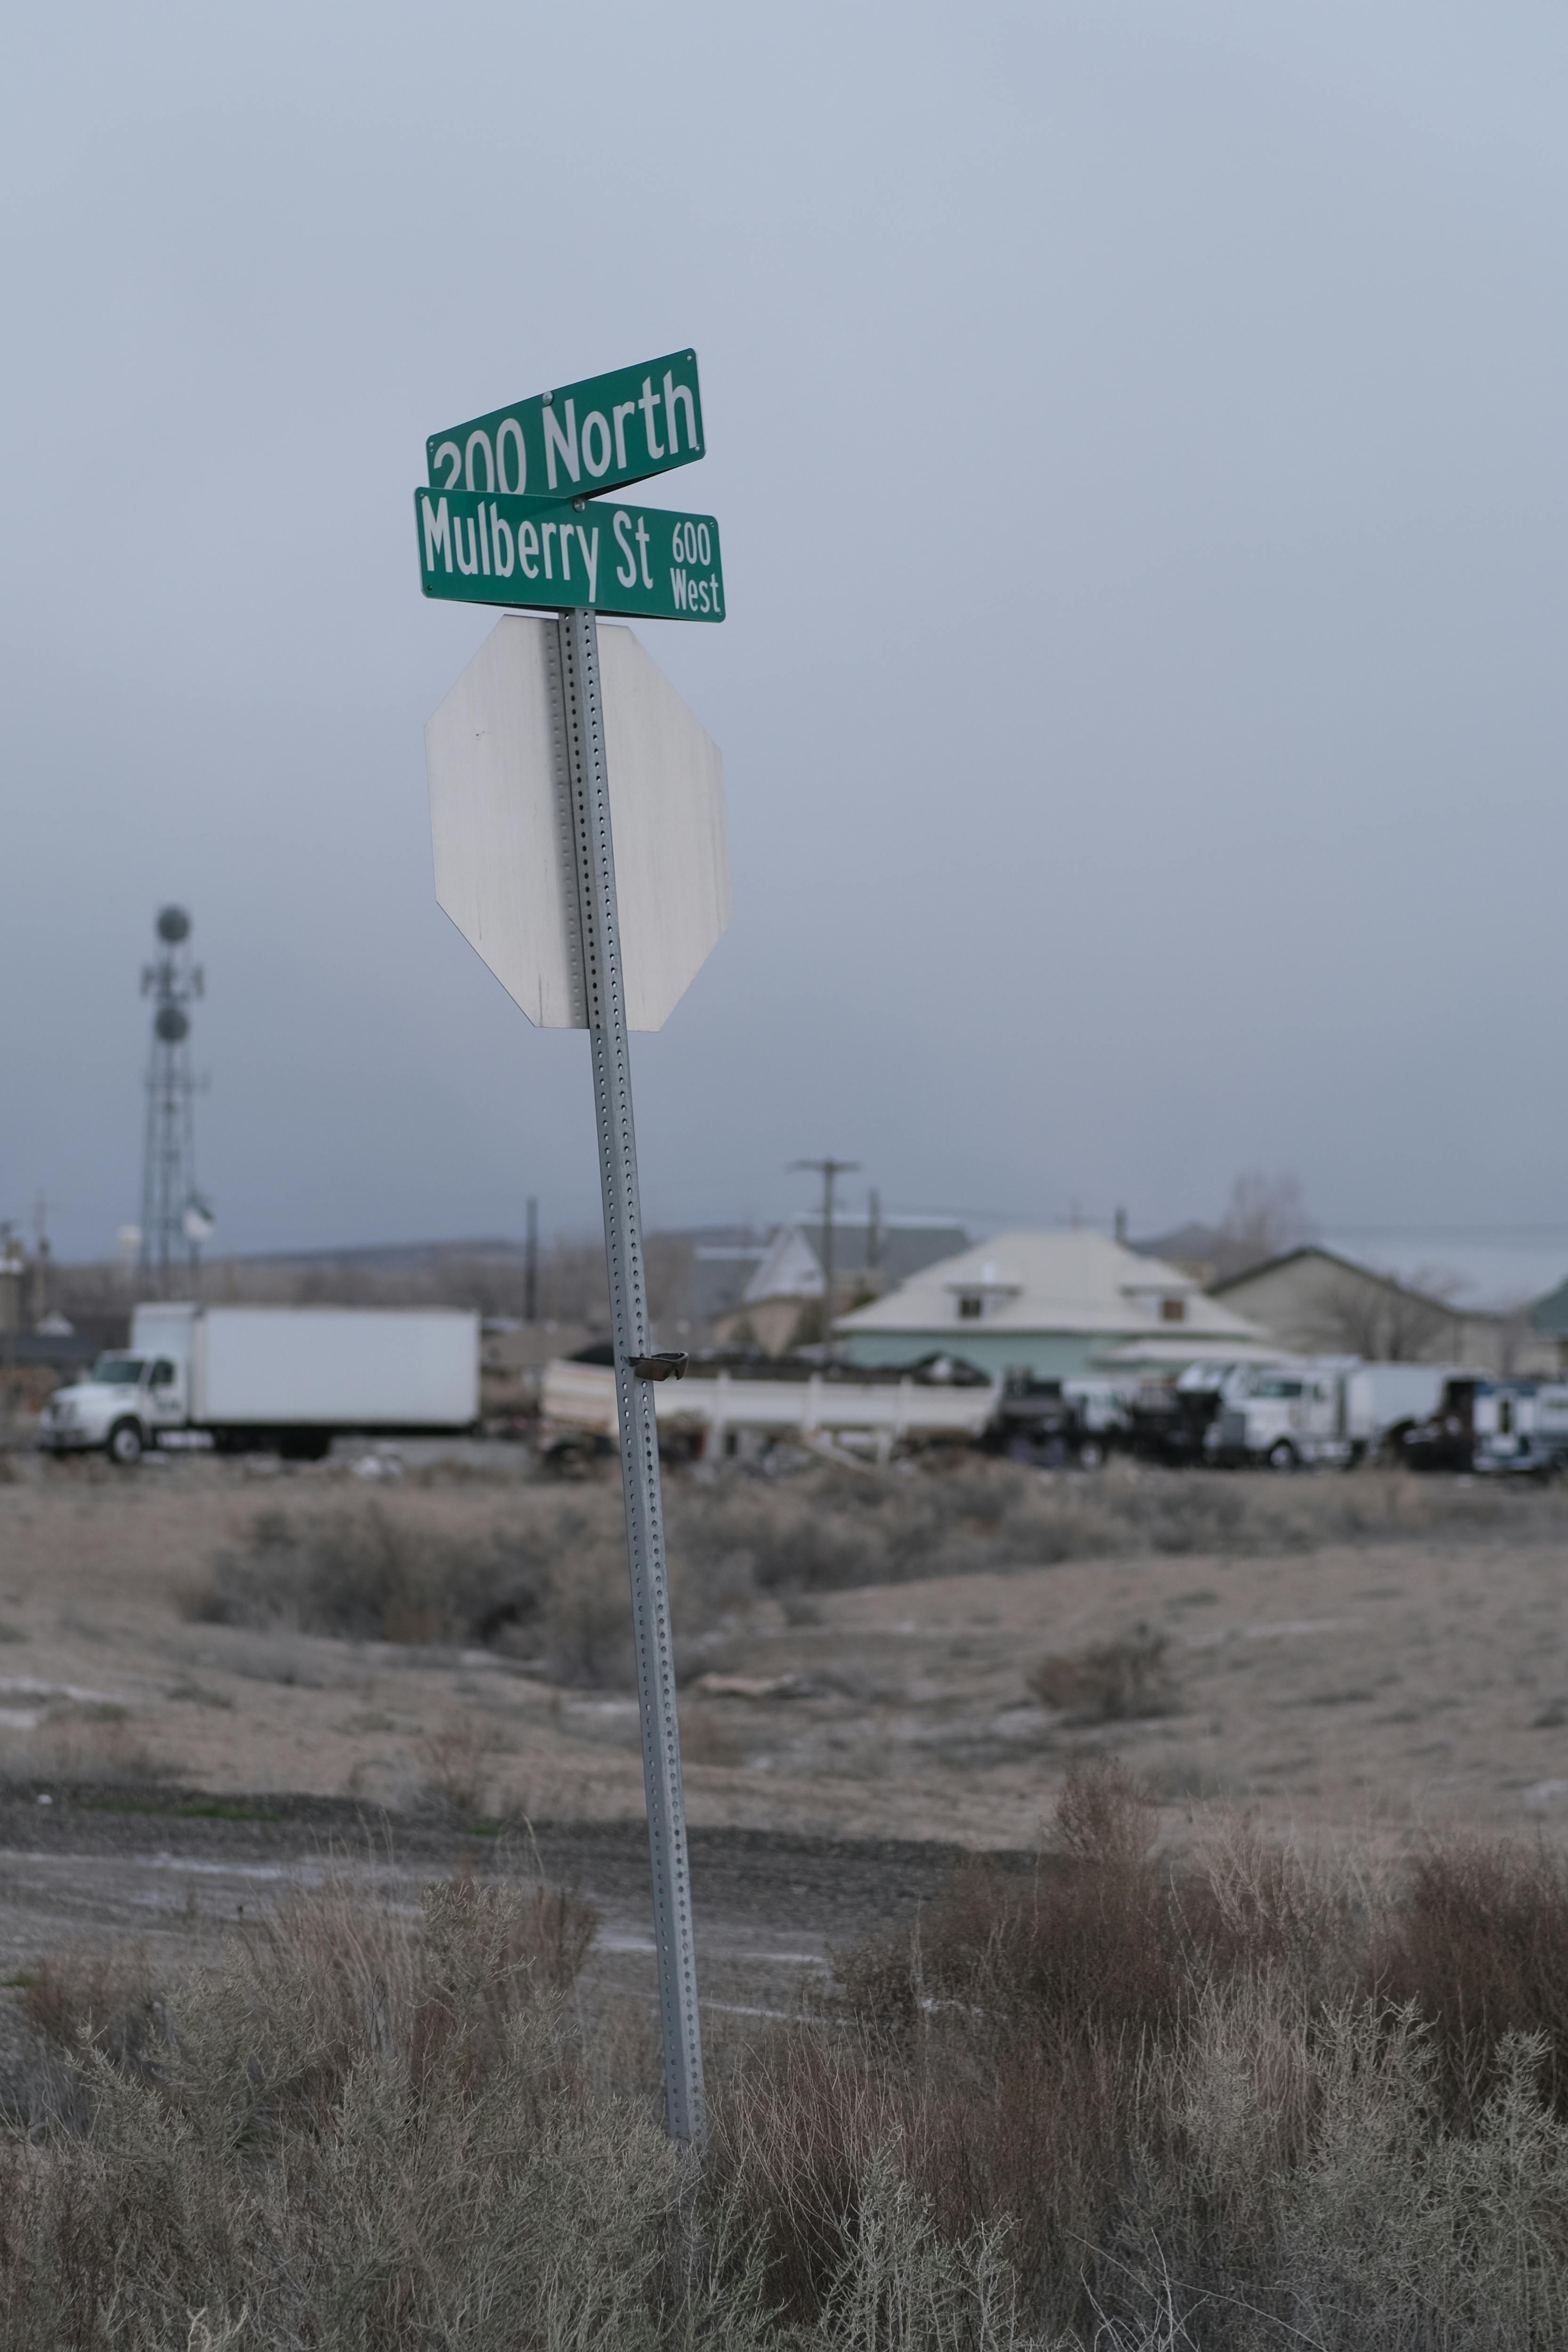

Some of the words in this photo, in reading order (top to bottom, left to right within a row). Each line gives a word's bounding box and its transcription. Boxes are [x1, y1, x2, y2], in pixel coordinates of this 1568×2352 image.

[433, 418, 527, 495] 200
[542, 370, 697, 490] North
[421, 496, 599, 603] Mulberry
[613, 510, 653, 589] St
[672, 522, 711, 565] 600
[670, 568, 721, 613] West
